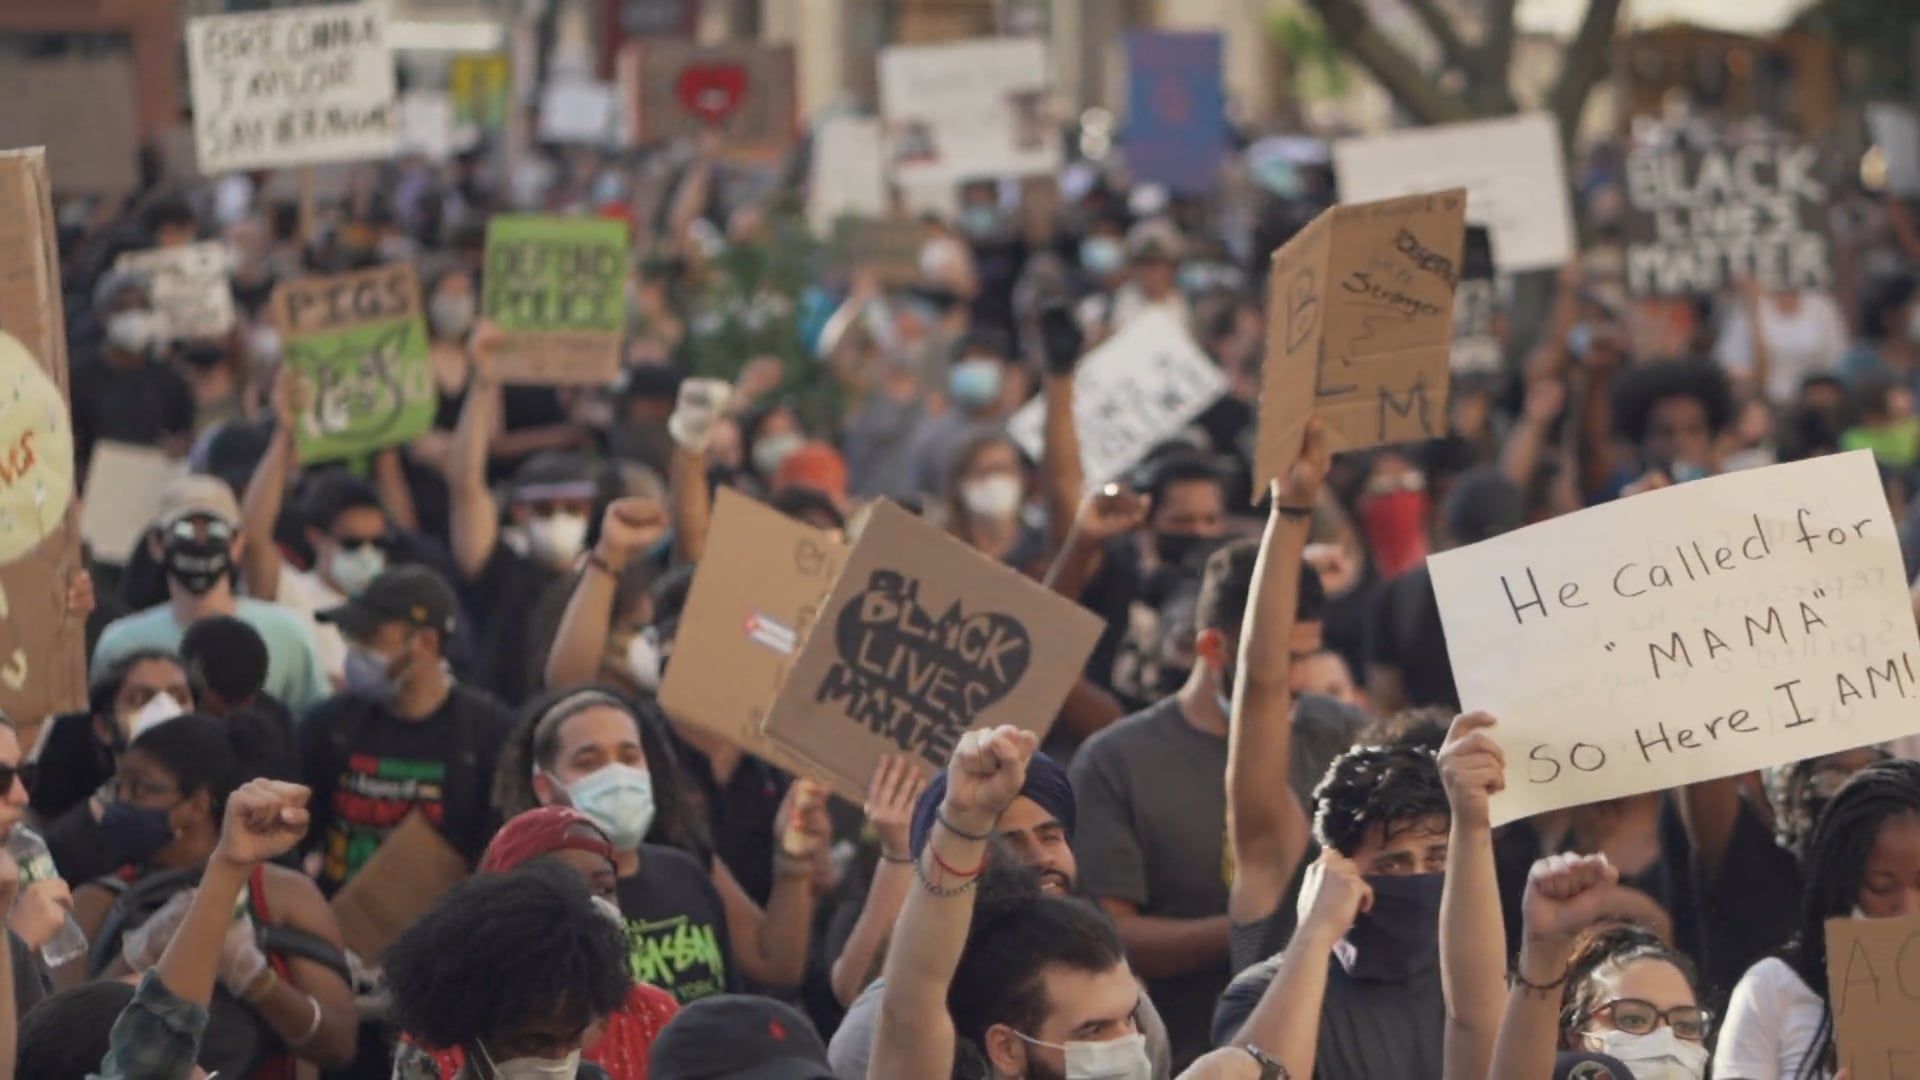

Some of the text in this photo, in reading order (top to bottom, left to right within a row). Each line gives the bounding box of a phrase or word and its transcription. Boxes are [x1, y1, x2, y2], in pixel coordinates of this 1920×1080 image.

[1626, 144, 1829, 212] BLACK
[286, 272, 409, 327] PIGS
[1626, 230, 1831, 298] MATTER
[1500, 565, 1589, 625] He
[1795, 507, 1873, 554] for
[859, 569, 1027, 683] BLACK
[815, 661, 960, 768] MATTE
[856, 629, 990, 727] LIVES
[1634, 708, 1759, 763] Here
[1773, 678, 1816, 730] I
[1834, 651, 1919, 707] AM!
